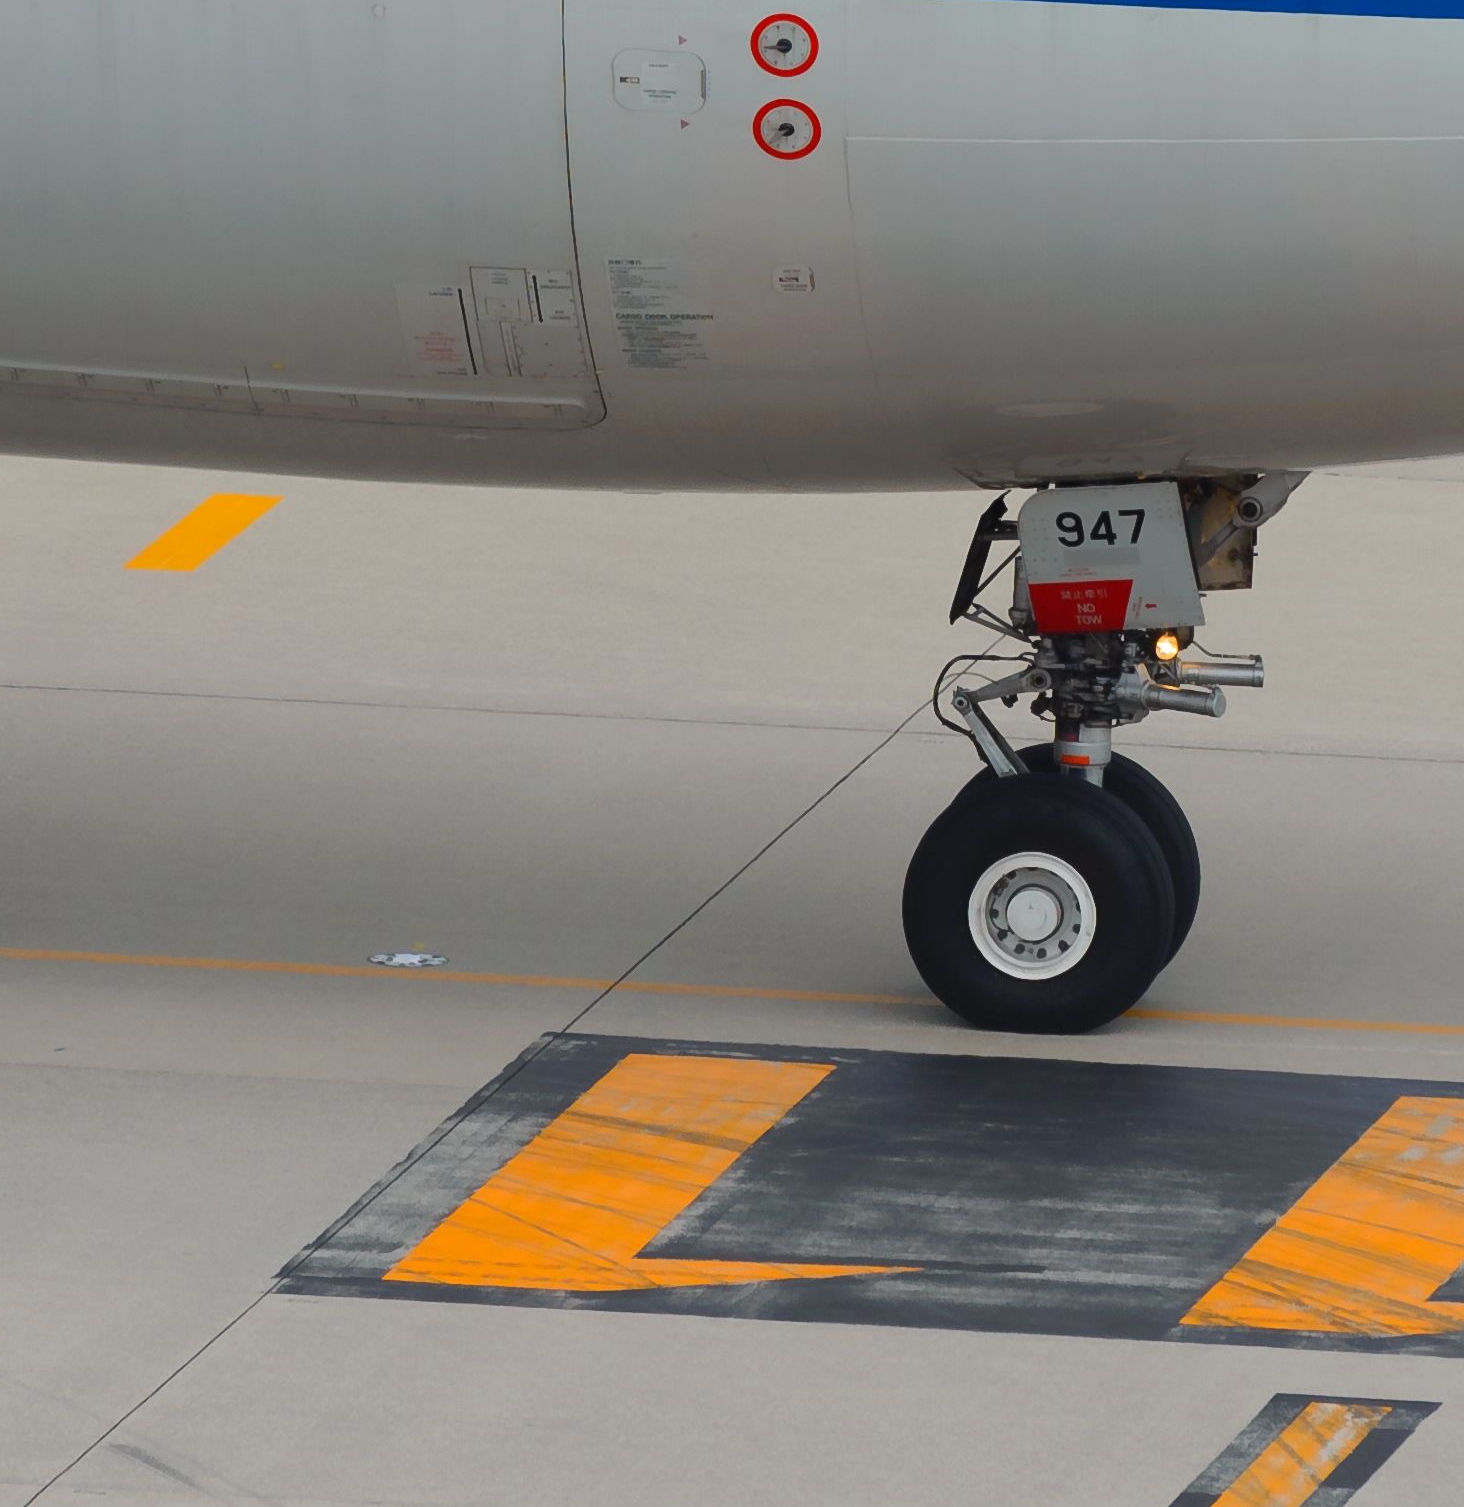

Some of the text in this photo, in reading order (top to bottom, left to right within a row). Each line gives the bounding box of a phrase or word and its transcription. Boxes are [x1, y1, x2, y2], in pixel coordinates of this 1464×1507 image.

[1056, 509, 1145, 547] 947
[1077, 603, 1096, 613] NO
[1075, 614, 1102, 625] TOW
